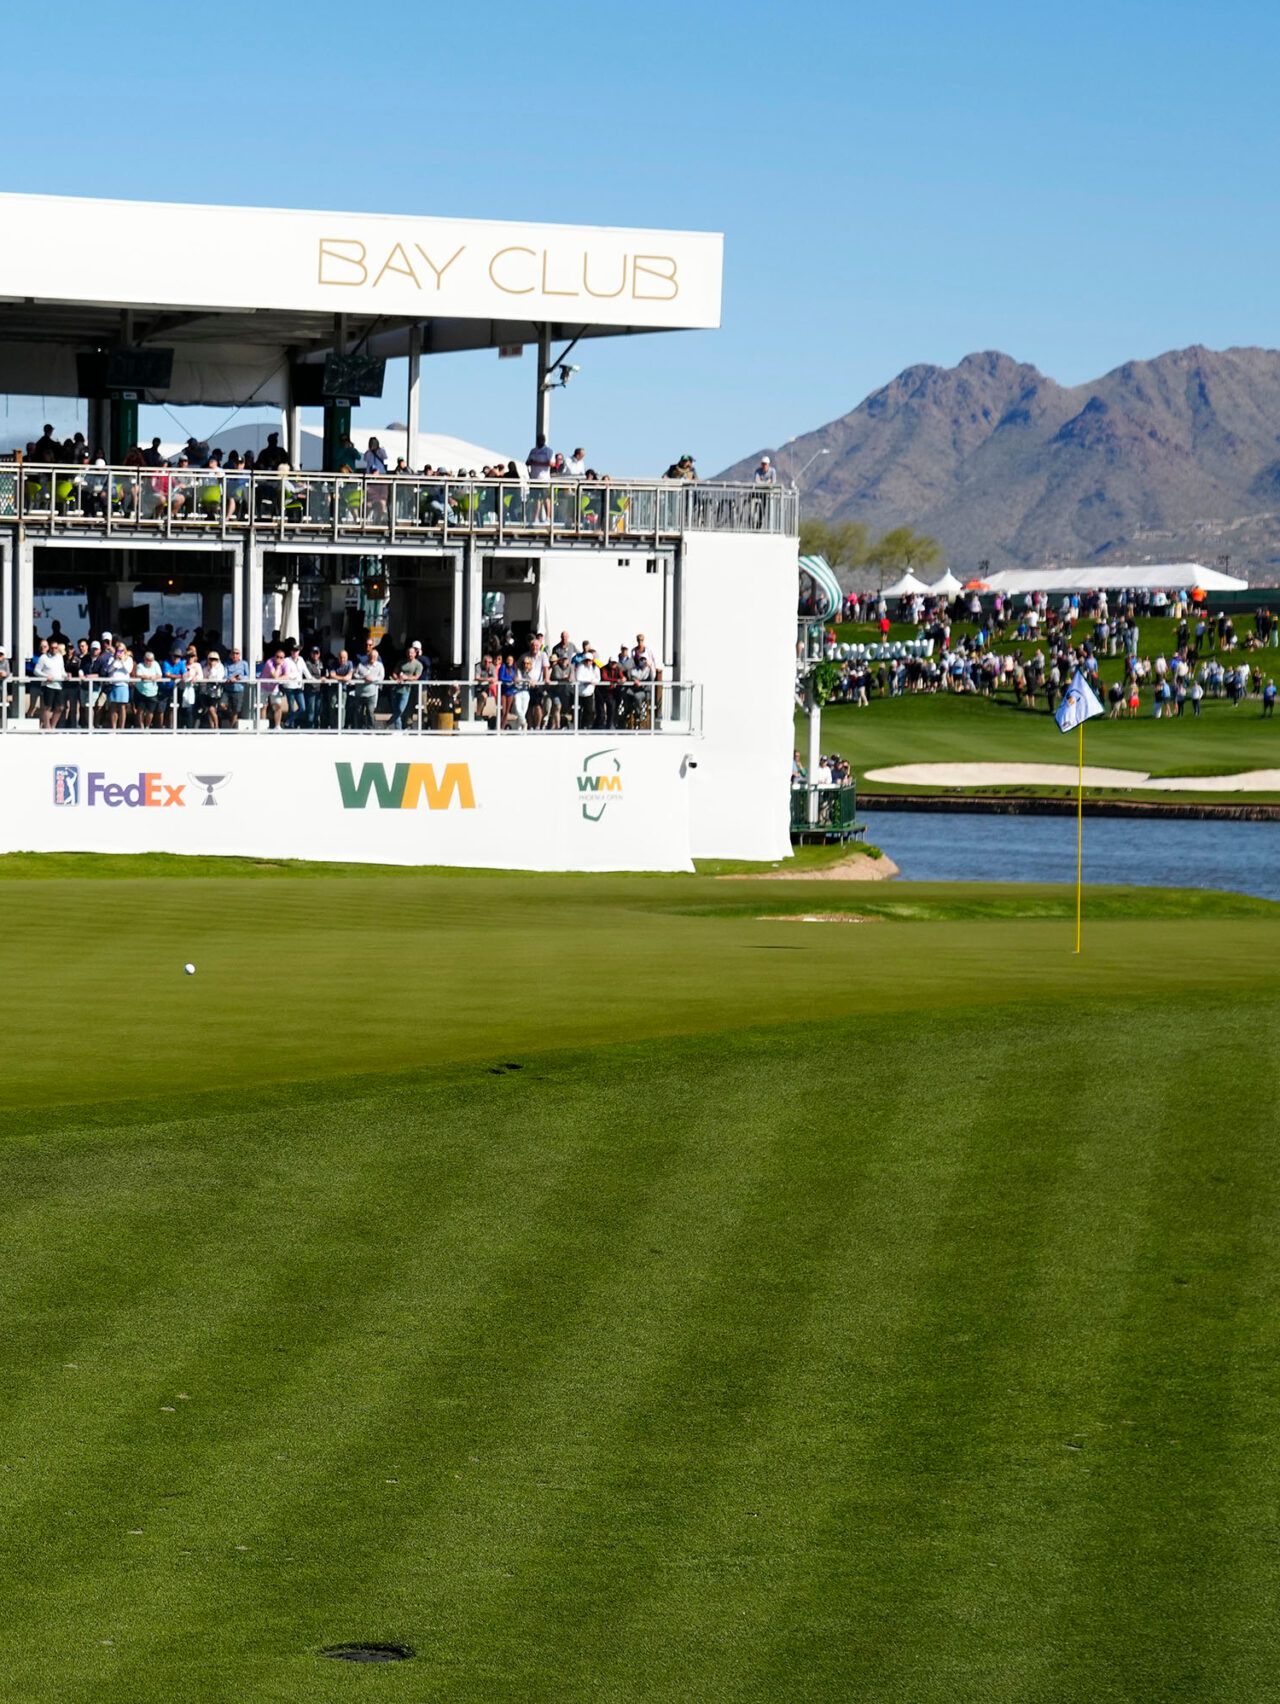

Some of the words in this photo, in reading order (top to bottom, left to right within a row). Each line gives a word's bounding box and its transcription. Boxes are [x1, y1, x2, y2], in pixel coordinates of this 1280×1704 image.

[318, 238, 466, 290] BAY
[488, 246, 678, 301] CLUB
[87, 772, 186, 808] FedEx
[334, 762, 476, 810] WM
[577, 776, 623, 791] WM
